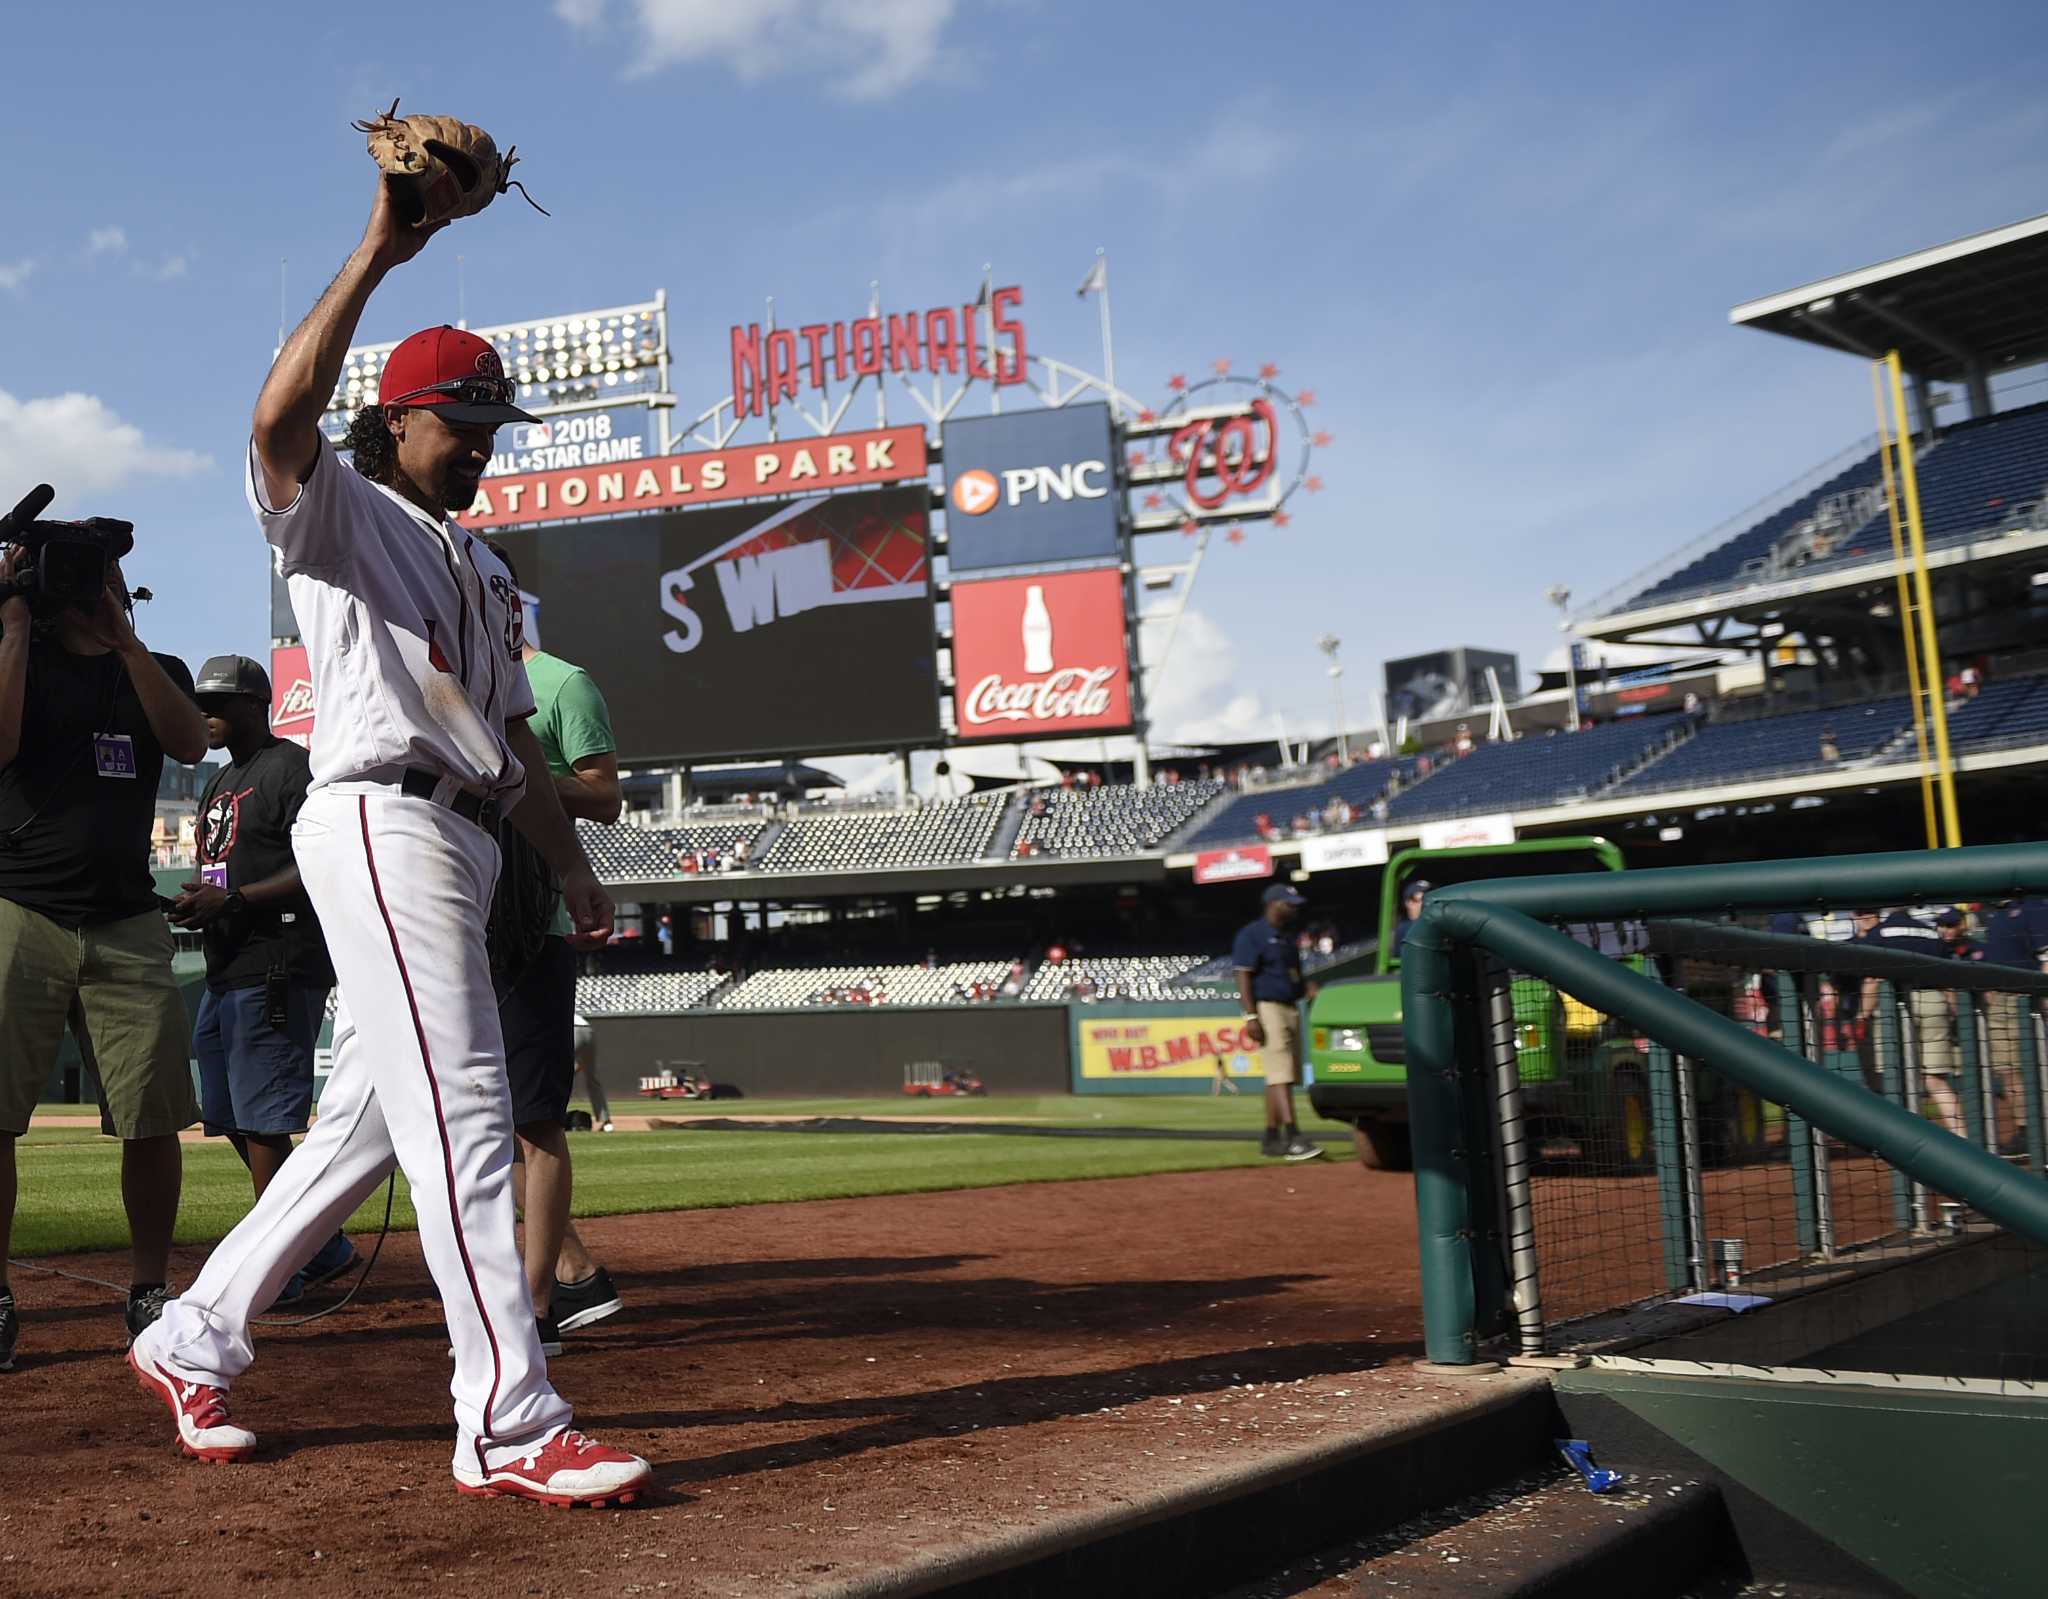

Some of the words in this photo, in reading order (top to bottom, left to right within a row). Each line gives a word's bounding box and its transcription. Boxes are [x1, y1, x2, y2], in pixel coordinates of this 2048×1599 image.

[731, 285, 1028, 419] NATIONALS
[554, 414, 612, 445] 2018
[583, 435, 643, 465] GAME
[447, 459, 727, 517] ATIONALS
[754, 438, 895, 483] PARK
[1001, 459, 1108, 507] PNC
[964, 665, 1120, 725] Coca-Cola
